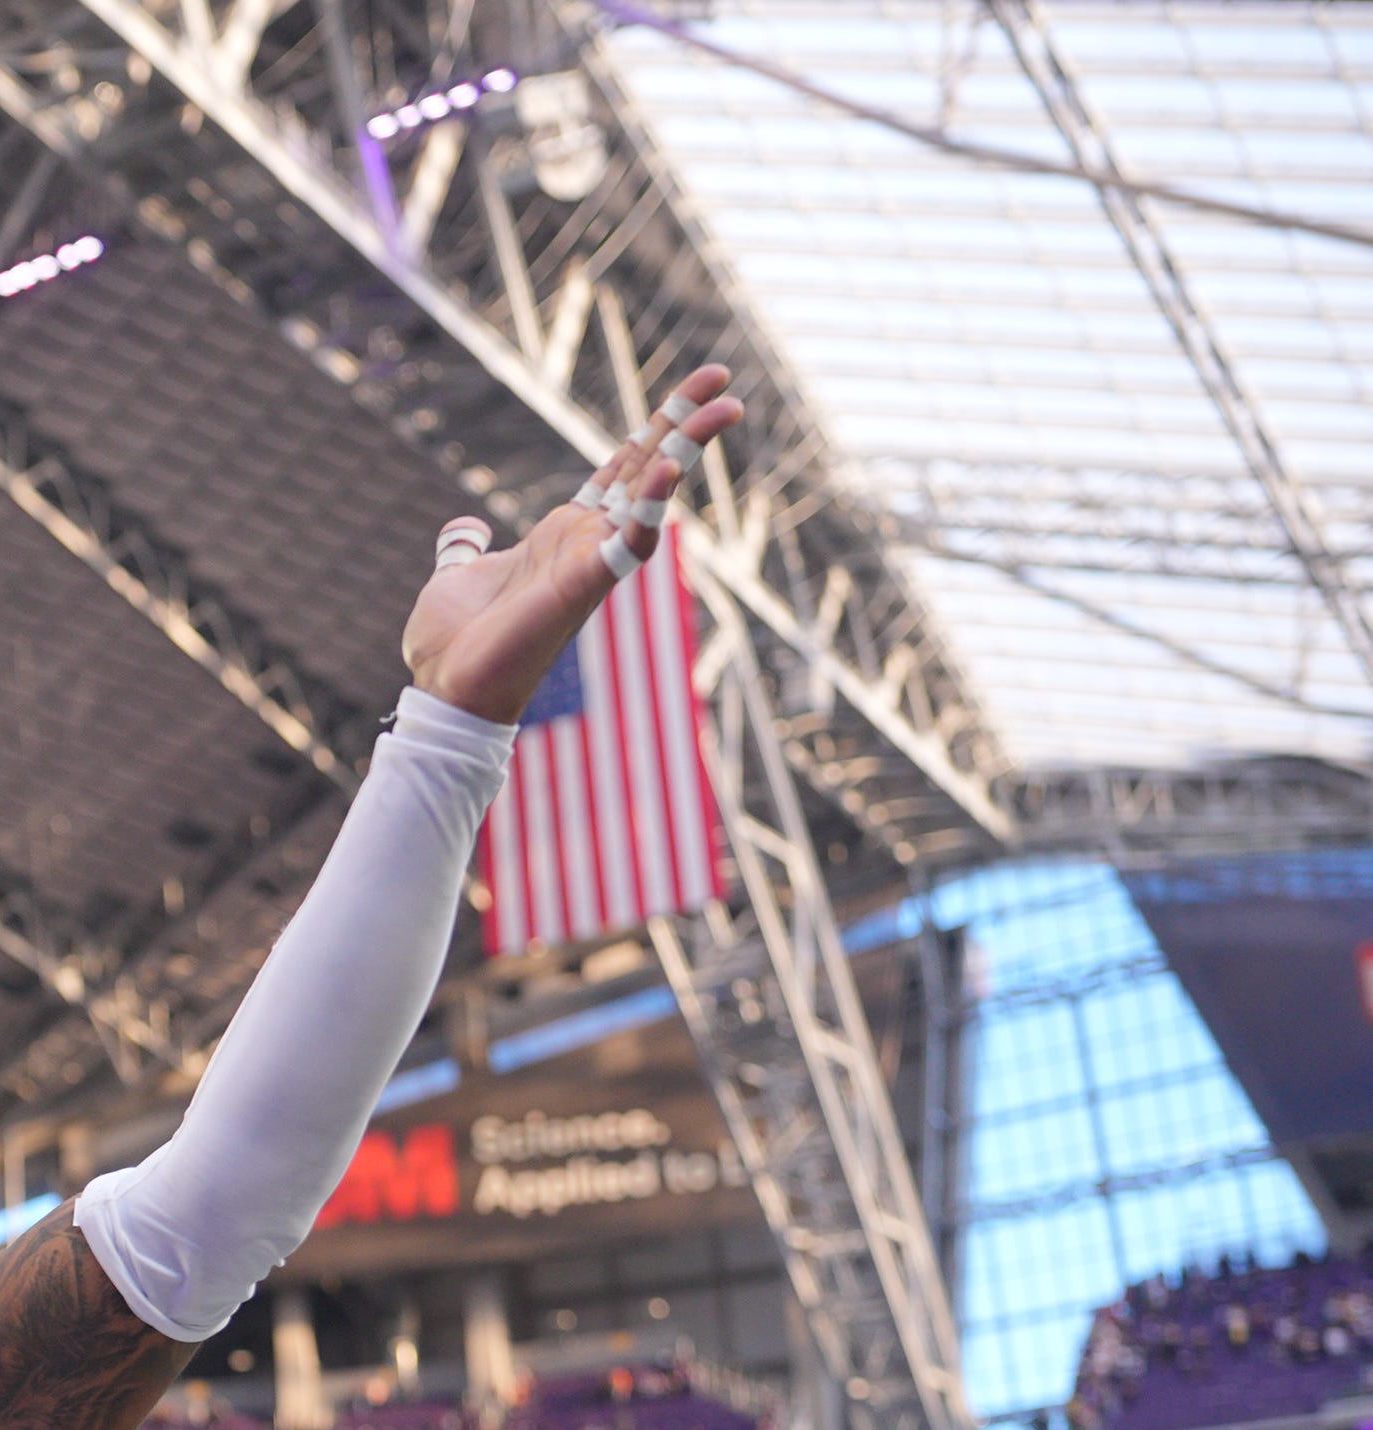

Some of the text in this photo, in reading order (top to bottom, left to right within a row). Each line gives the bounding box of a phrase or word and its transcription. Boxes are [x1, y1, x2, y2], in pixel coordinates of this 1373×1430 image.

[313, 1121, 458, 1231] M
[473, 1149, 660, 1218] Applied
[662, 1149, 717, 1195] to
